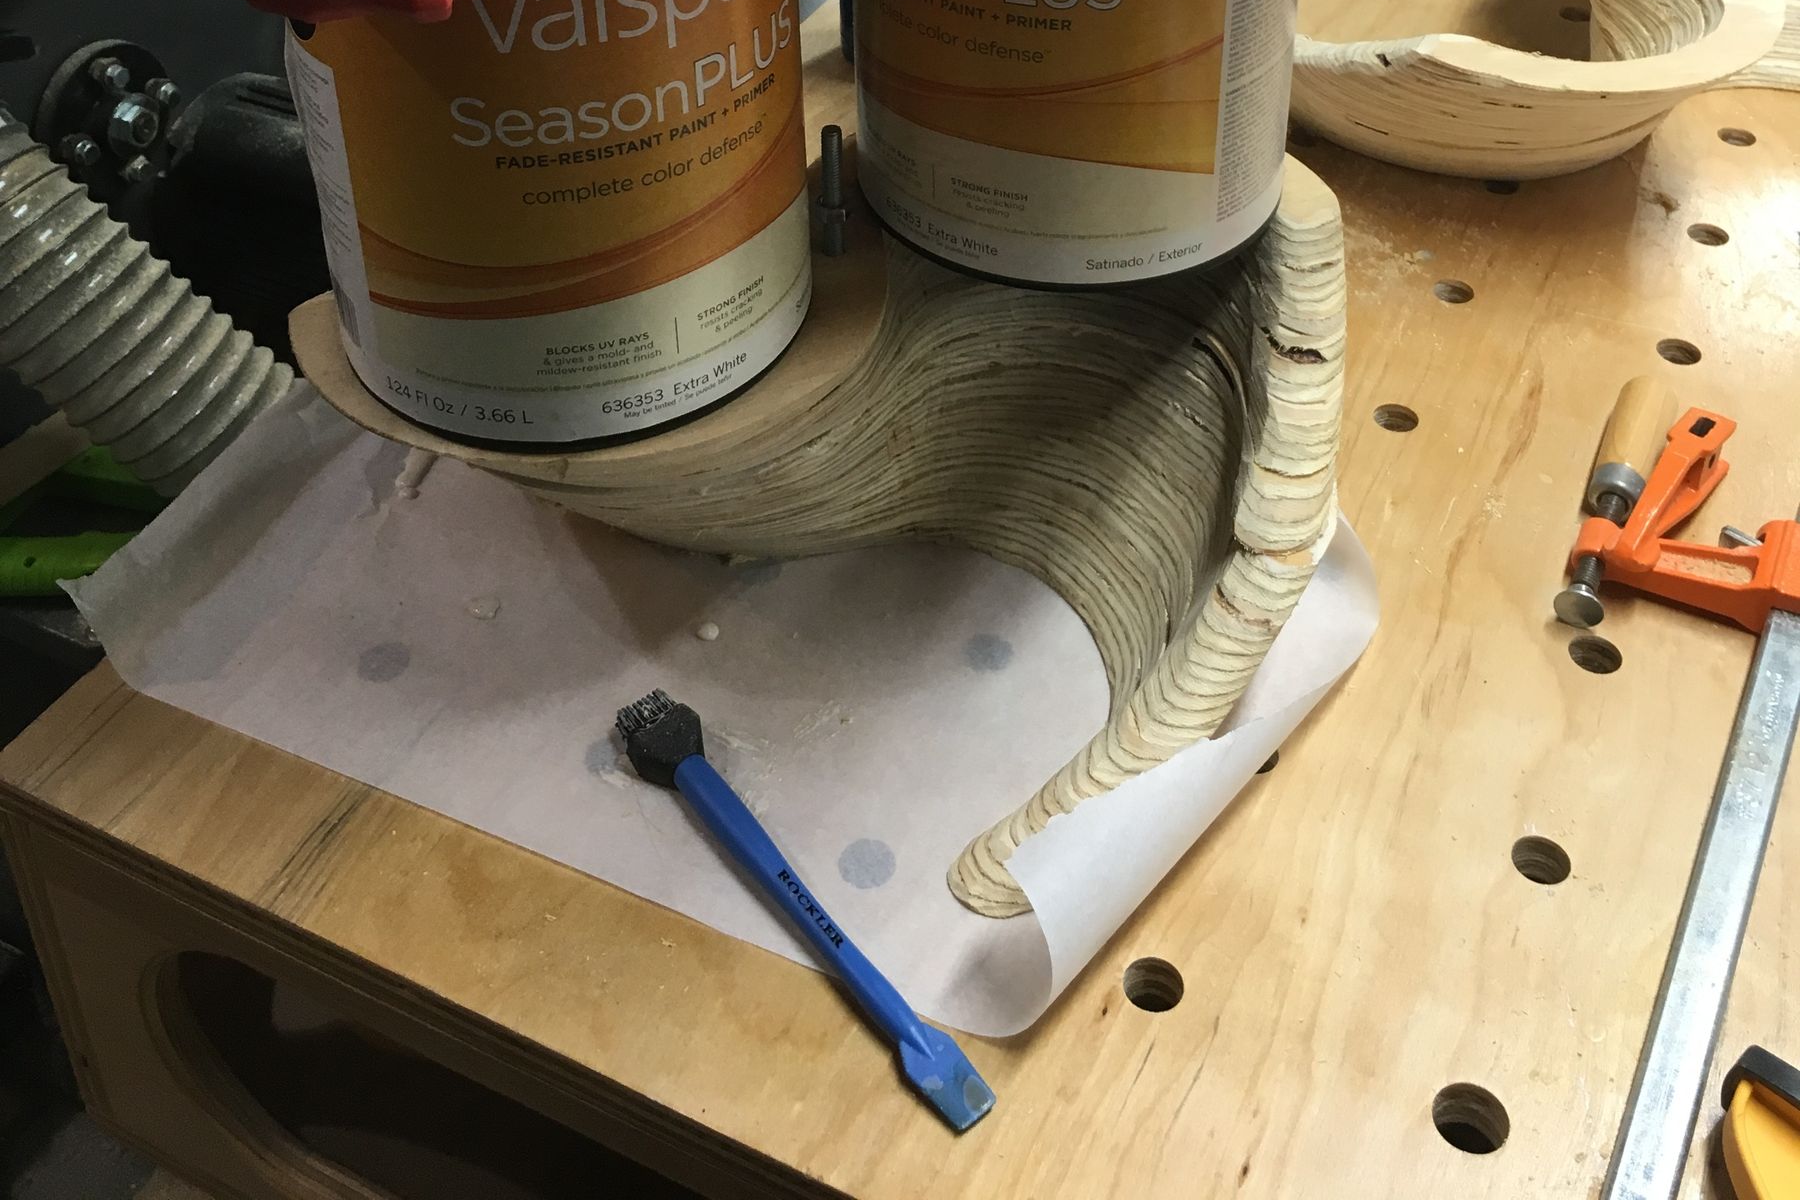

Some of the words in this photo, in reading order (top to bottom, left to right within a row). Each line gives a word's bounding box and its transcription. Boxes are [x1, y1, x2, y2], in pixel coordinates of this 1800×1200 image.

[917, 20, 959, 46] color
[991, 13, 1000, 22] +
[1006, 14, 1072, 32] PRIMER
[495, 132, 663, 170] FADE-RESISTANT
[669, 111, 717, 142] PAINT
[721, 107, 730, 118] +
[733, 72, 776, 110] PRIMER
[522, 176, 634, 206] complete
[641, 156, 696, 187] color
[950, 177, 991, 196] STRONG
[994, 189, 1028, 201] FINISH
[928, 222, 958, 244] Extra
[962, 235, 999, 256] White
[1086, 256, 1144, 271] Satinado
[1148, 253, 1154, 265] /
[1159, 241, 1203, 262] Exterior
[697, 295, 736, 321] STRONG
[738, 275, 764, 300] FINISH
[700, 311, 729, 330] resists
[731, 288, 763, 314] cracking
[715, 324, 721, 333] &
[723, 306, 753, 329] peeling
[543, 358, 550, 366] &
[554, 357, 584, 367] gives
[598, 348, 631, 360] mold-
[634, 341, 654, 353] and
[546, 343, 595, 356] BLOCKS
[598, 339, 616, 350] UV
[619, 332, 650, 346] RAYS
[536, 358, 631, 376] mildew-resistant
[633, 349, 662, 363] finish
[602, 389, 664, 414] 636353
[673, 374, 709, 396] Extra
[713, 351, 747, 378] White
[624, 410, 640, 419] May
[643, 406, 653, 415] be
[655, 399, 676, 413] tinted
[696, 385, 715, 398] puede
[718, 373, 733, 384] teñir
[386, 376, 412, 399] 124
[434, 397, 455, 415] Oz
[461, 404, 467, 416] /
[475, 406, 516, 423] 3.66
[523, 410, 533, 424] L
[778, 869, 844, 949] ROCKLER
